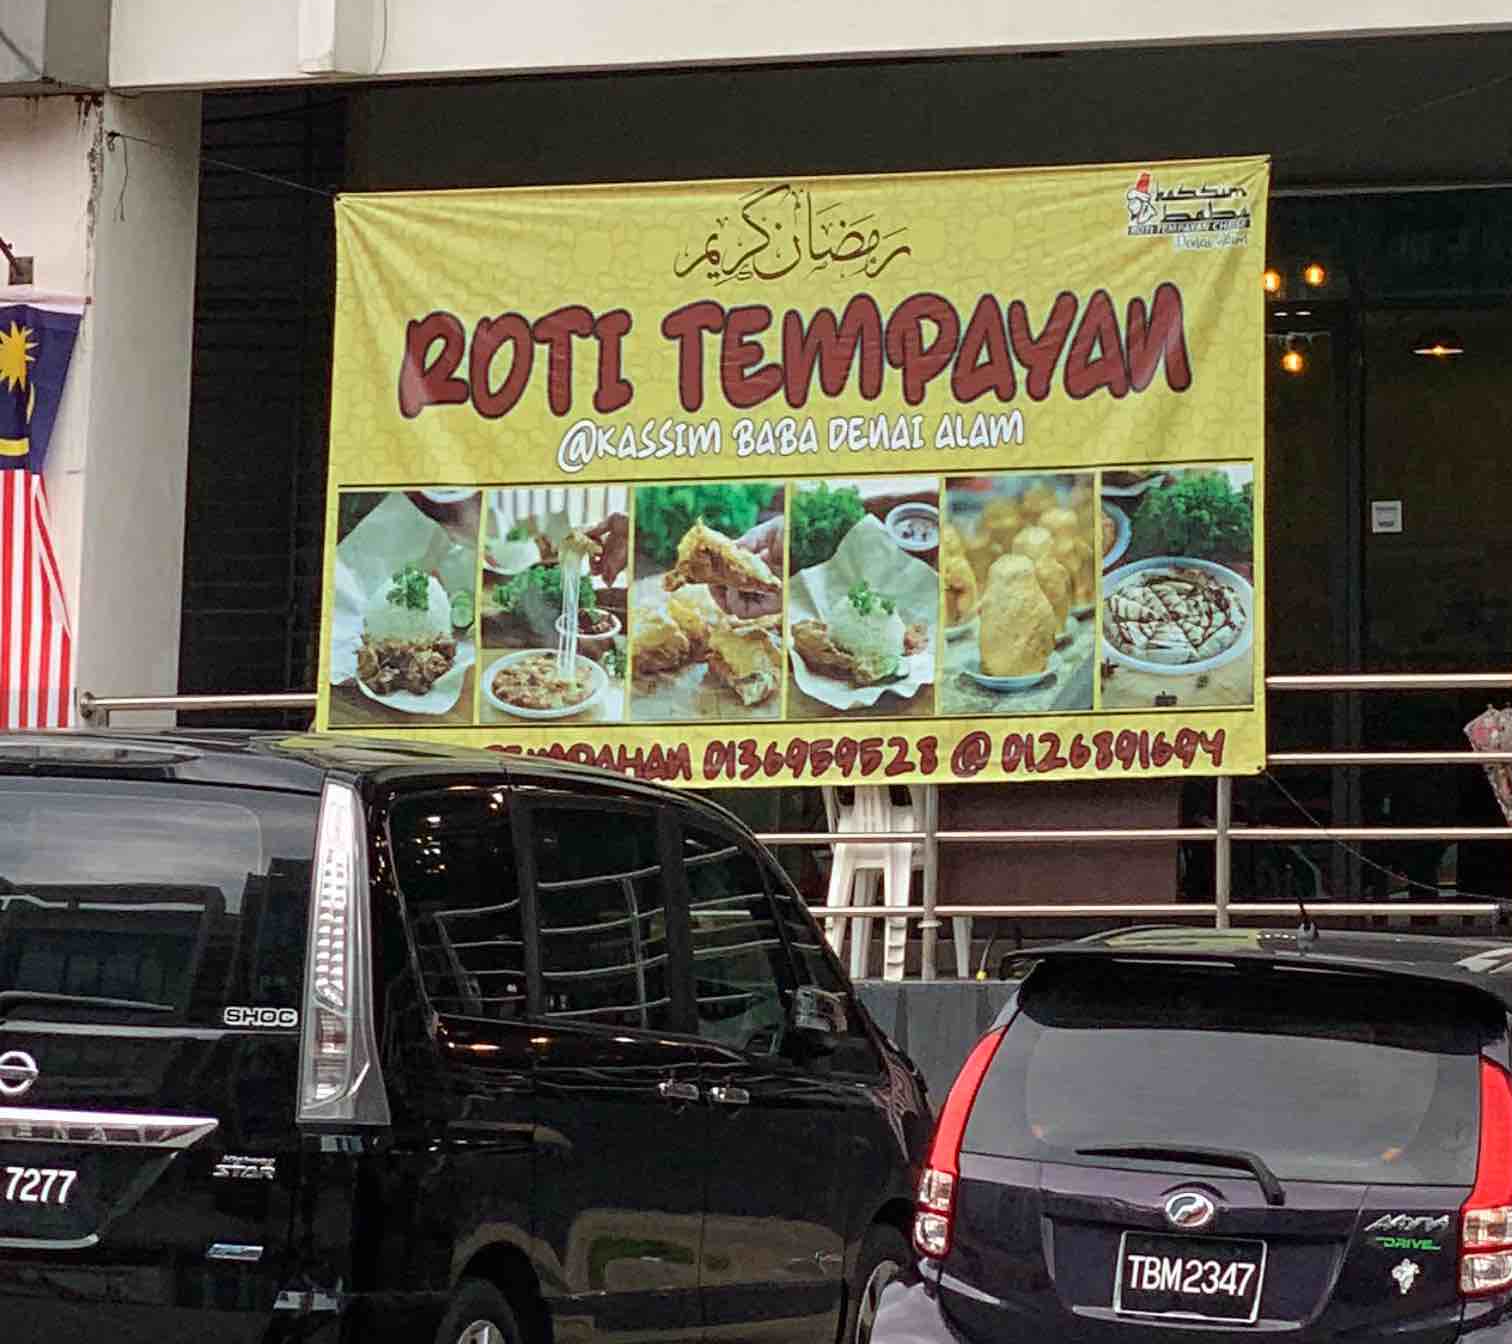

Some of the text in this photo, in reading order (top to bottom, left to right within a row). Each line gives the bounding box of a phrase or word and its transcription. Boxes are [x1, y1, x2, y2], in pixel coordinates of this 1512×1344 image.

[399, 281, 1193, 419] ROTI TEMPAYAN
[556, 409, 1026, 474] @KASSIM BABA DENAI ALAM
[702, 735, 938, 781] 0136959528
[950, 730, 992, 778] @
[1000, 727, 1226, 774] 0126891694
[225, 1006, 298, 1026] SHOC
[5, 1165, 78, 1205] 7277
[1127, 1254, 1256, 1297] TBM2347
